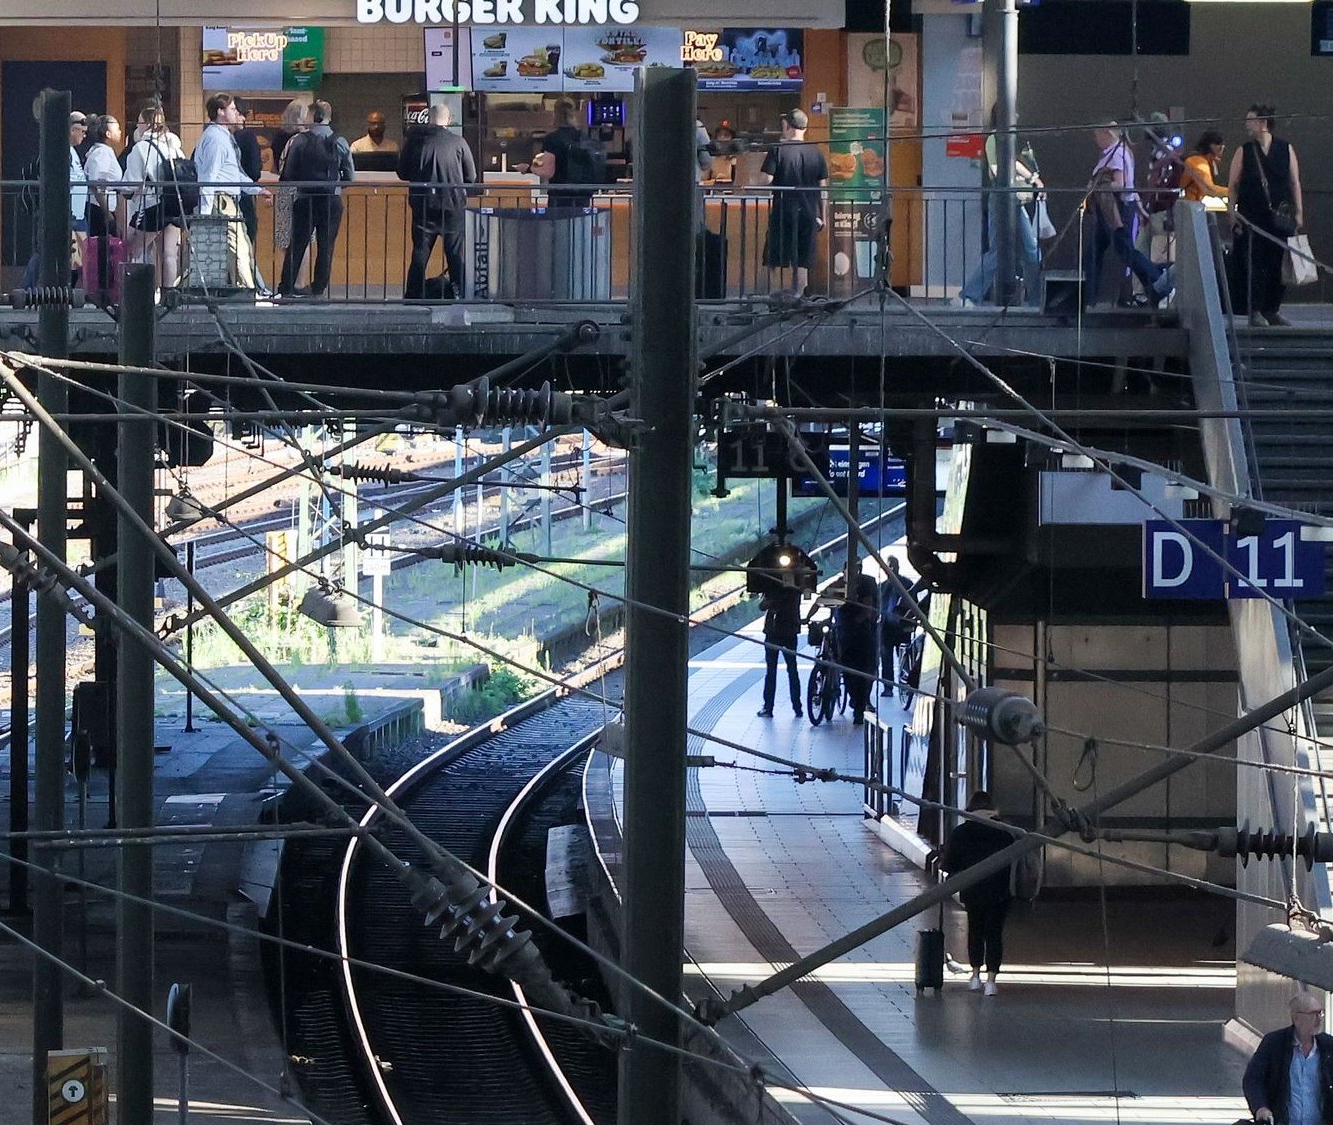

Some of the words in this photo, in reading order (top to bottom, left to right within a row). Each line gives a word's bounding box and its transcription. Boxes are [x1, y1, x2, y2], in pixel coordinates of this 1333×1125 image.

[356, 0, 525, 24] BURGER
[534, 0, 641, 24] KING
[685, 31, 718, 50] Pay
[680, 45, 723, 61] Here
[1153, 531, 1193, 588] D
[1236, 531, 1304, 588] 11
